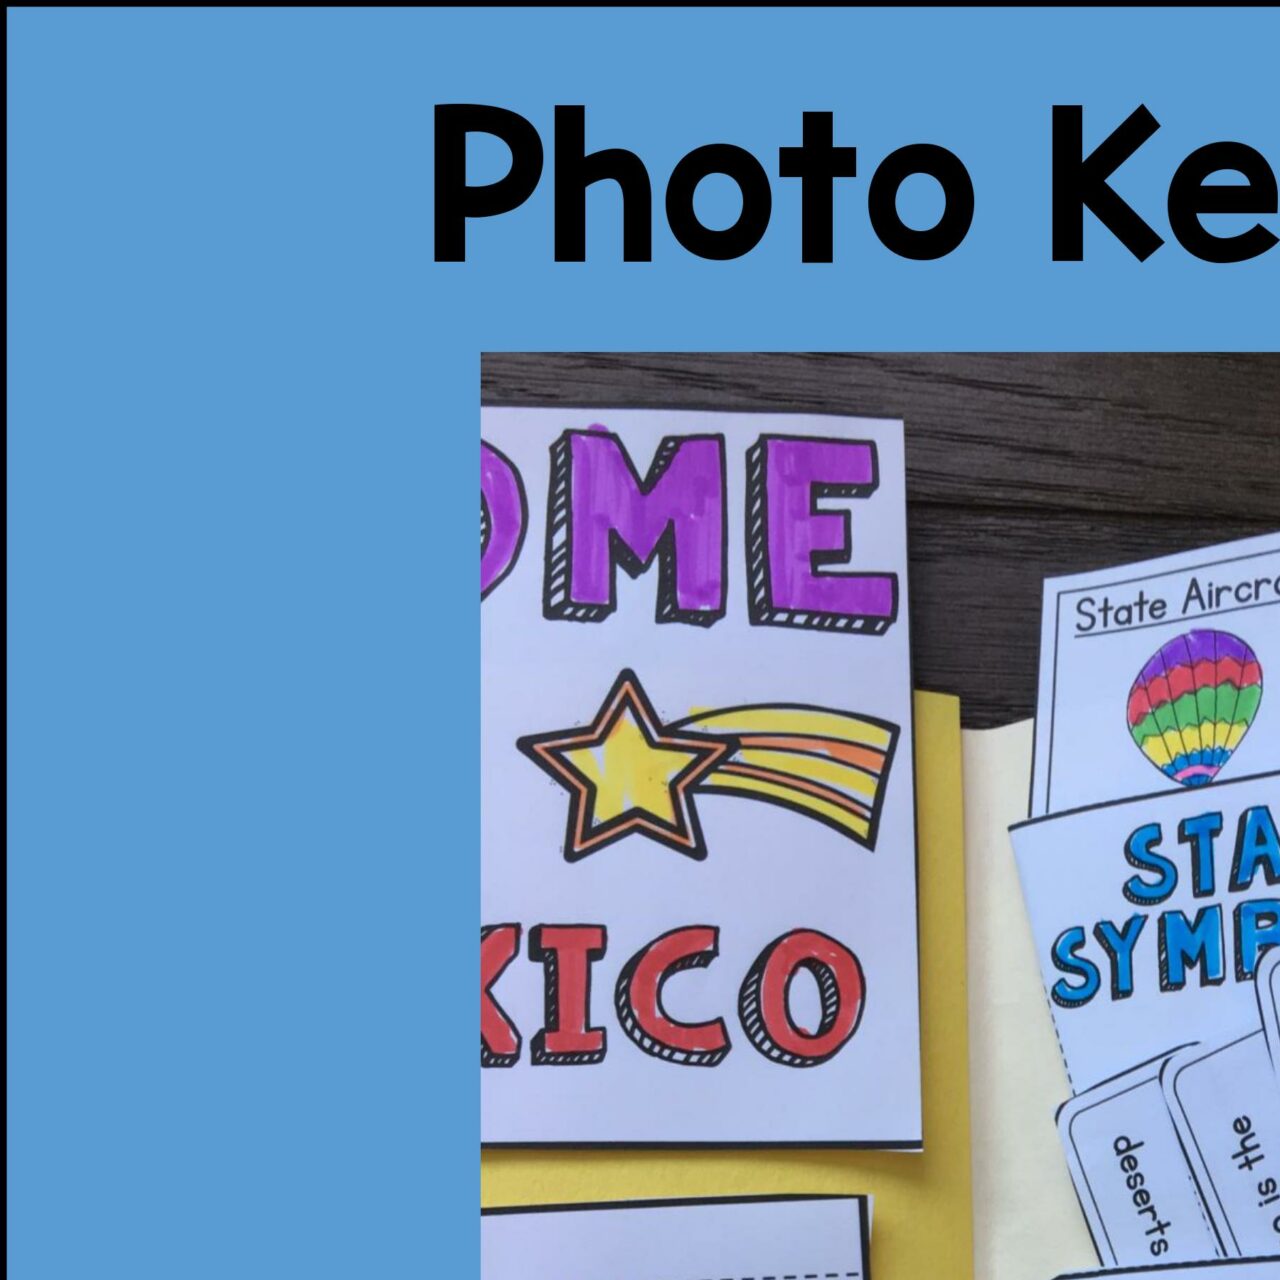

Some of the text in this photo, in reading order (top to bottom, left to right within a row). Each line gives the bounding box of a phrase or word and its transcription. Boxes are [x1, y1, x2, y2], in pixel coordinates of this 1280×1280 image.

[1074, 590, 1168, 633] State
[1231, 1114, 1265, 1172] the
[1113, 1135, 1172, 1257] deserts
[1258, 1176, 1280, 1208] is
